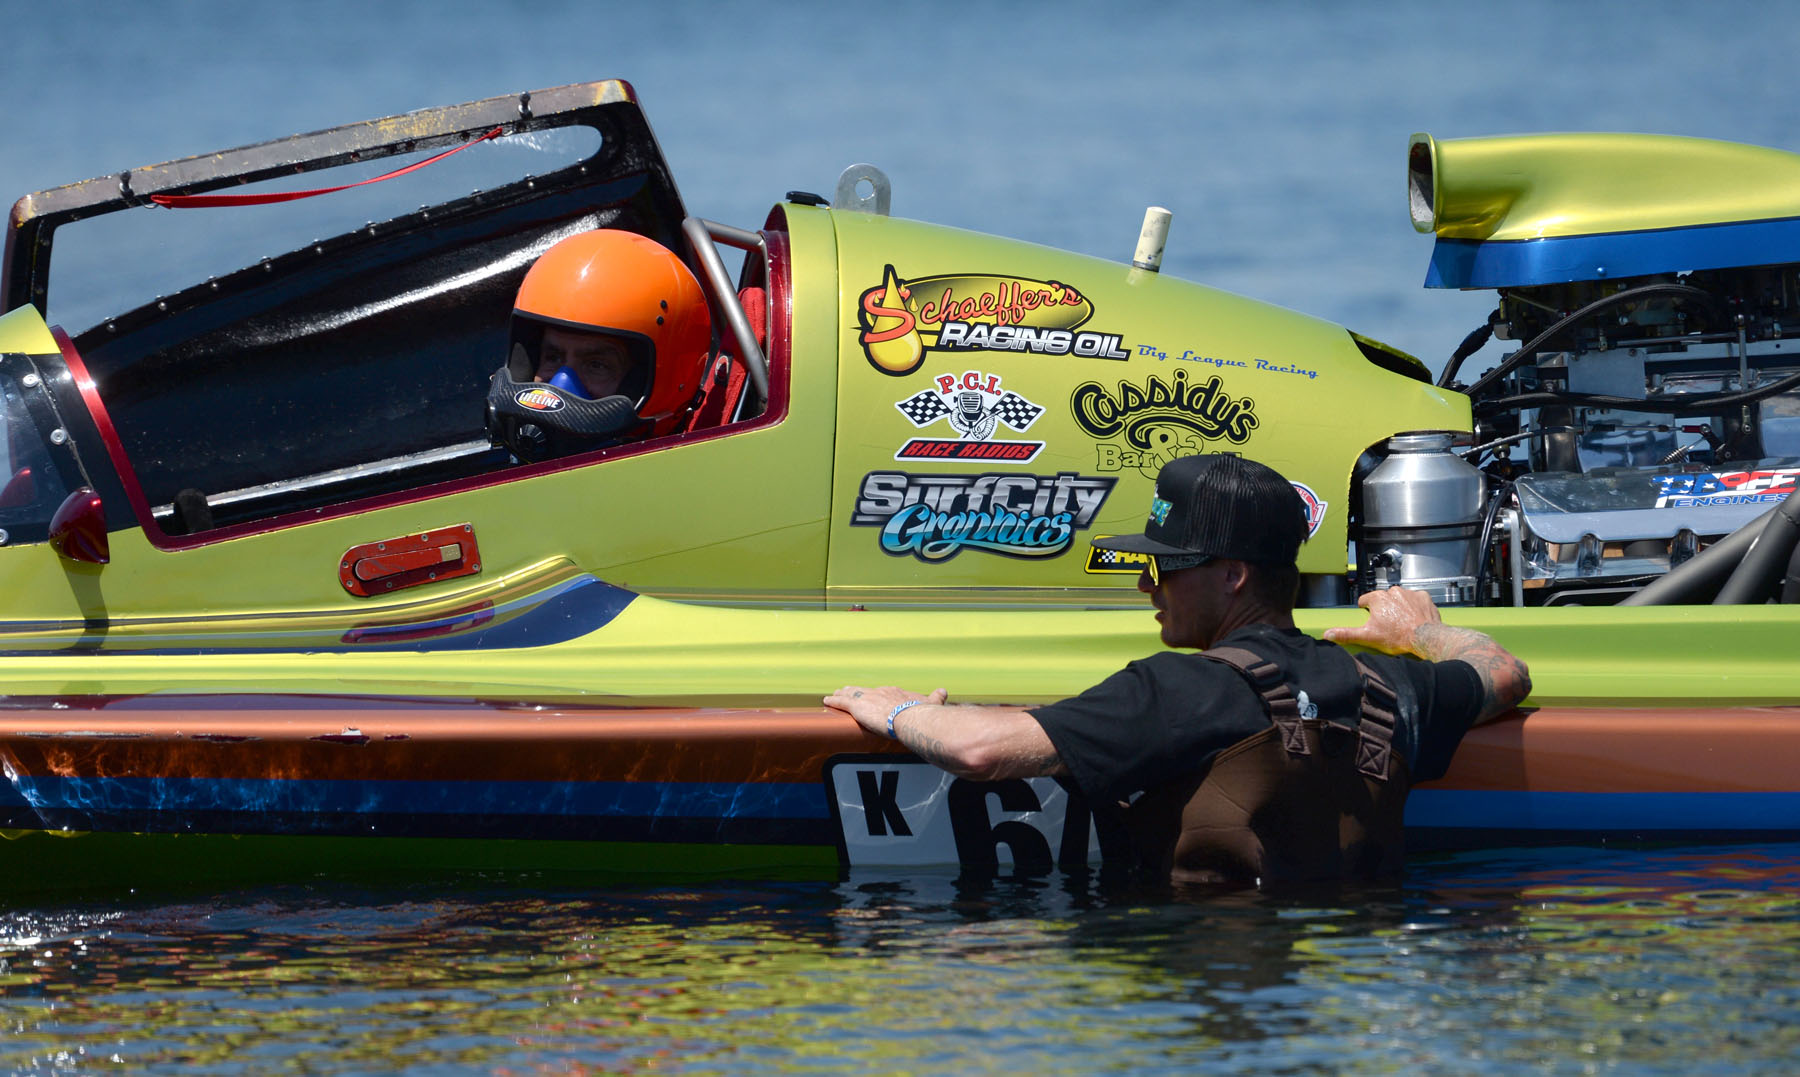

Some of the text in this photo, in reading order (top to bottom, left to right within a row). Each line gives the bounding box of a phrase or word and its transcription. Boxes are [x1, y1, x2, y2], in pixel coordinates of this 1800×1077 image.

[864, 282, 1083, 343] Schaeffer's
[940, 322, 1129, 359] RACING OIL
[1137, 344, 1319, 379] Big League Racing
[518, 391, 561, 409] LIFELINE
[937, 372, 1002, 396] P.C.I.
[1070, 368, 1260, 449] Cassidy's
[903, 442, 1037, 460] RACE RADIOS
[1096, 443, 1153, 472] Bar
[881, 504, 1073, 559] Graphics
[856, 770, 913, 837] K
